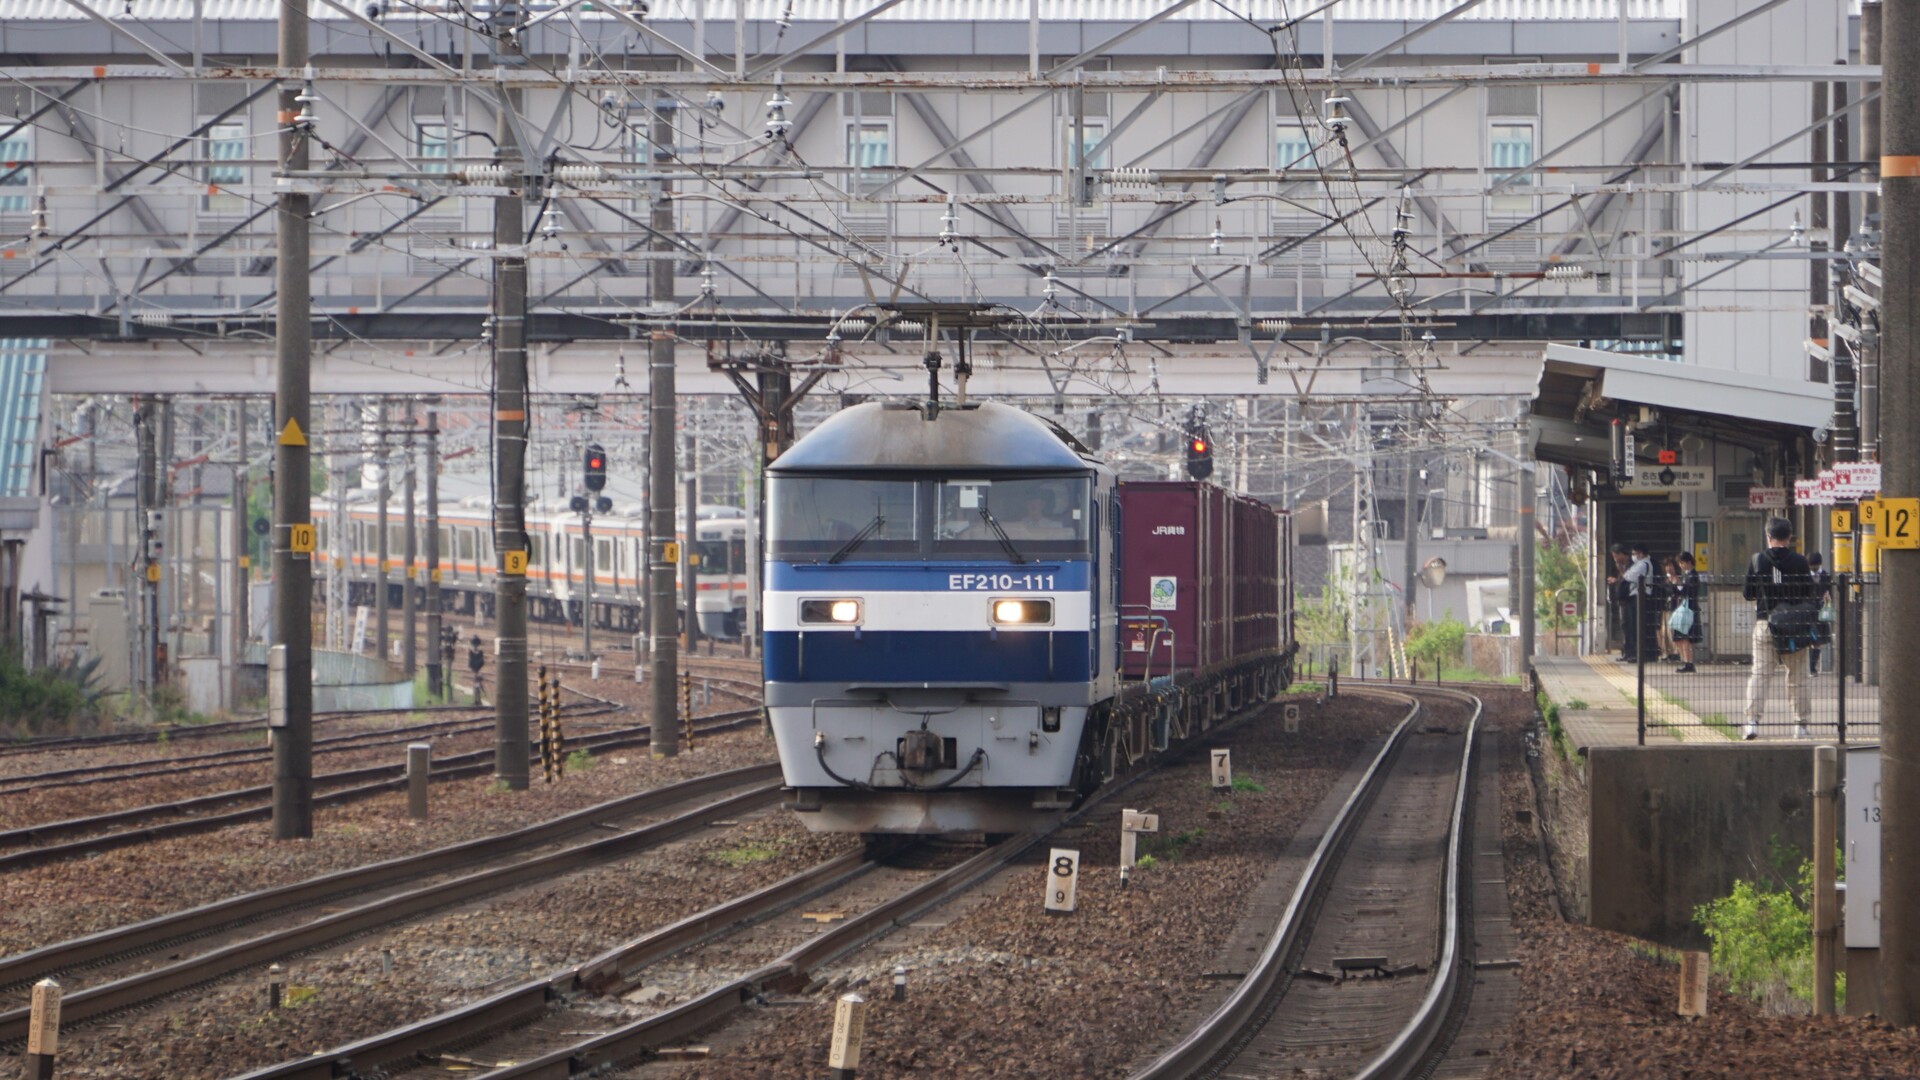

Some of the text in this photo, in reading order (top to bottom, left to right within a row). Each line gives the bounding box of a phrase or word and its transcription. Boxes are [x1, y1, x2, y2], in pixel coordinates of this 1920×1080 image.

[1866, 506, 1873, 519] 9
[1837, 515, 1844, 528] 8
[1885, 508, 1909, 538] 12
[1152, 525, 1185, 536] JR貨物
[296, 530, 309, 546] 10
[511, 555, 519, 569] 9
[949, 574, 1054, 590] EF210-111
[1286, 708, 1297, 719] 6
[1213, 753, 1227, 768] 7
[1862, 807, 1881, 823] 13
[1053, 856, 1074, 878] 8
[1056, 890, 1065, 904] 9
